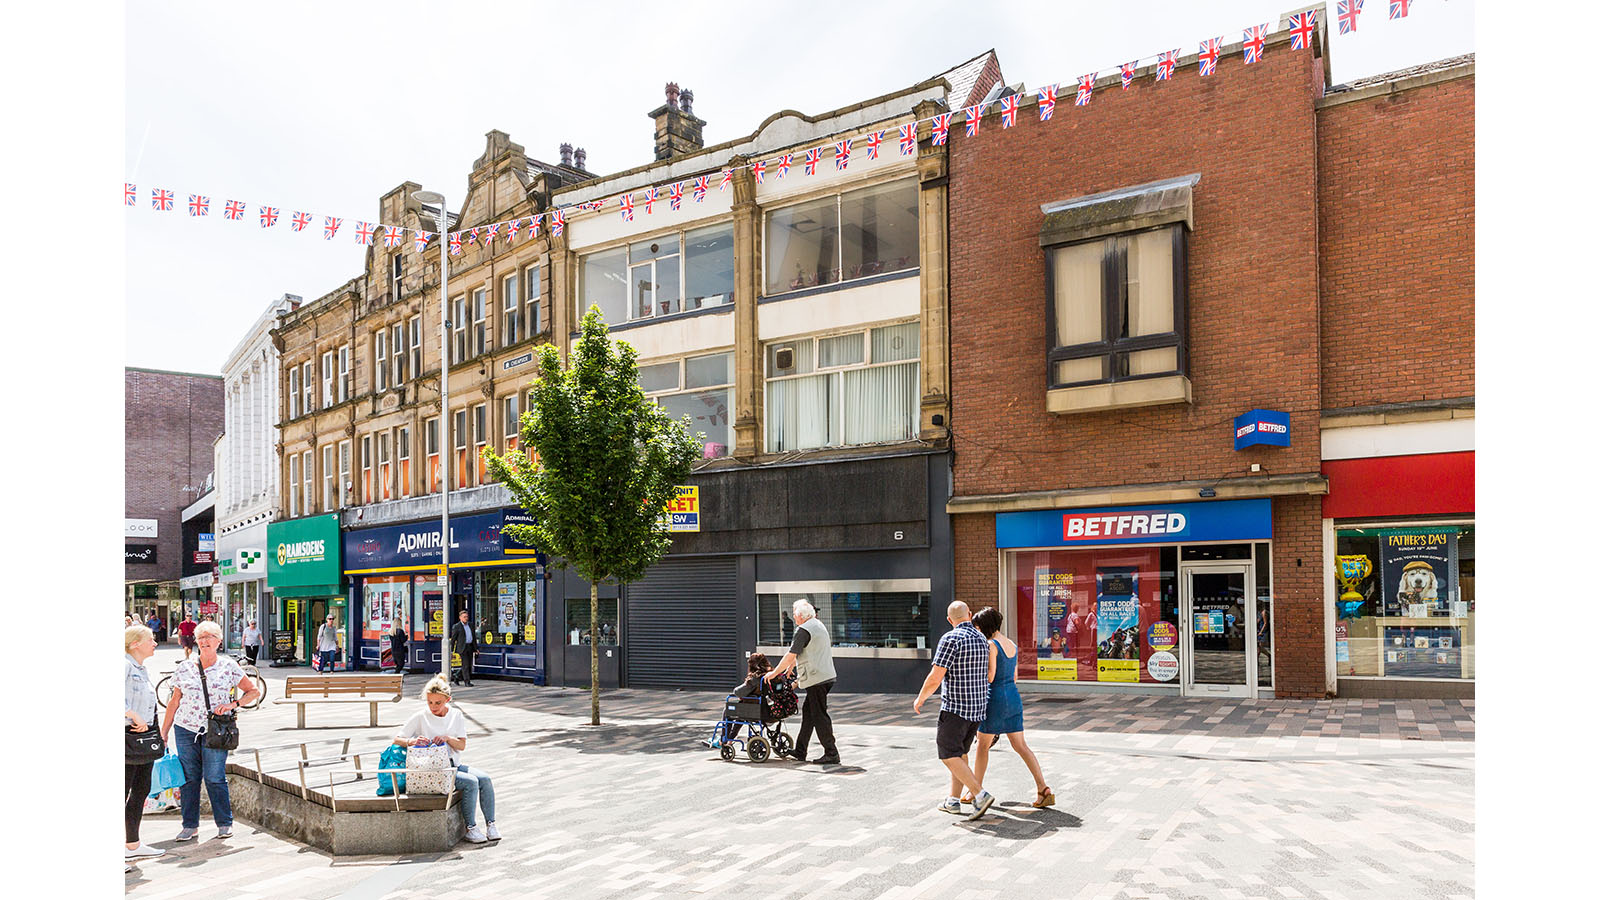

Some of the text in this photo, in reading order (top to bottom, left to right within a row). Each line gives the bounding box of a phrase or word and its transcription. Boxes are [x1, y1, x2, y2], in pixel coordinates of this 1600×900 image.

[1258, 422, 1287, 433] BETFRED
[668, 497, 696, 511] LET
[1067, 513, 1186, 537] BETFRED
[479, 530, 499, 541] CASI
[895, 531, 903, 540] 6
[1389, 533, 1447, 546] FATHER'S DAY
[286, 540, 325, 557] RAMSDENS
[357, 542, 381, 552] CASINO
[1342, 562, 1366, 570] BEST
[1344, 569, 1365, 579] DAD
